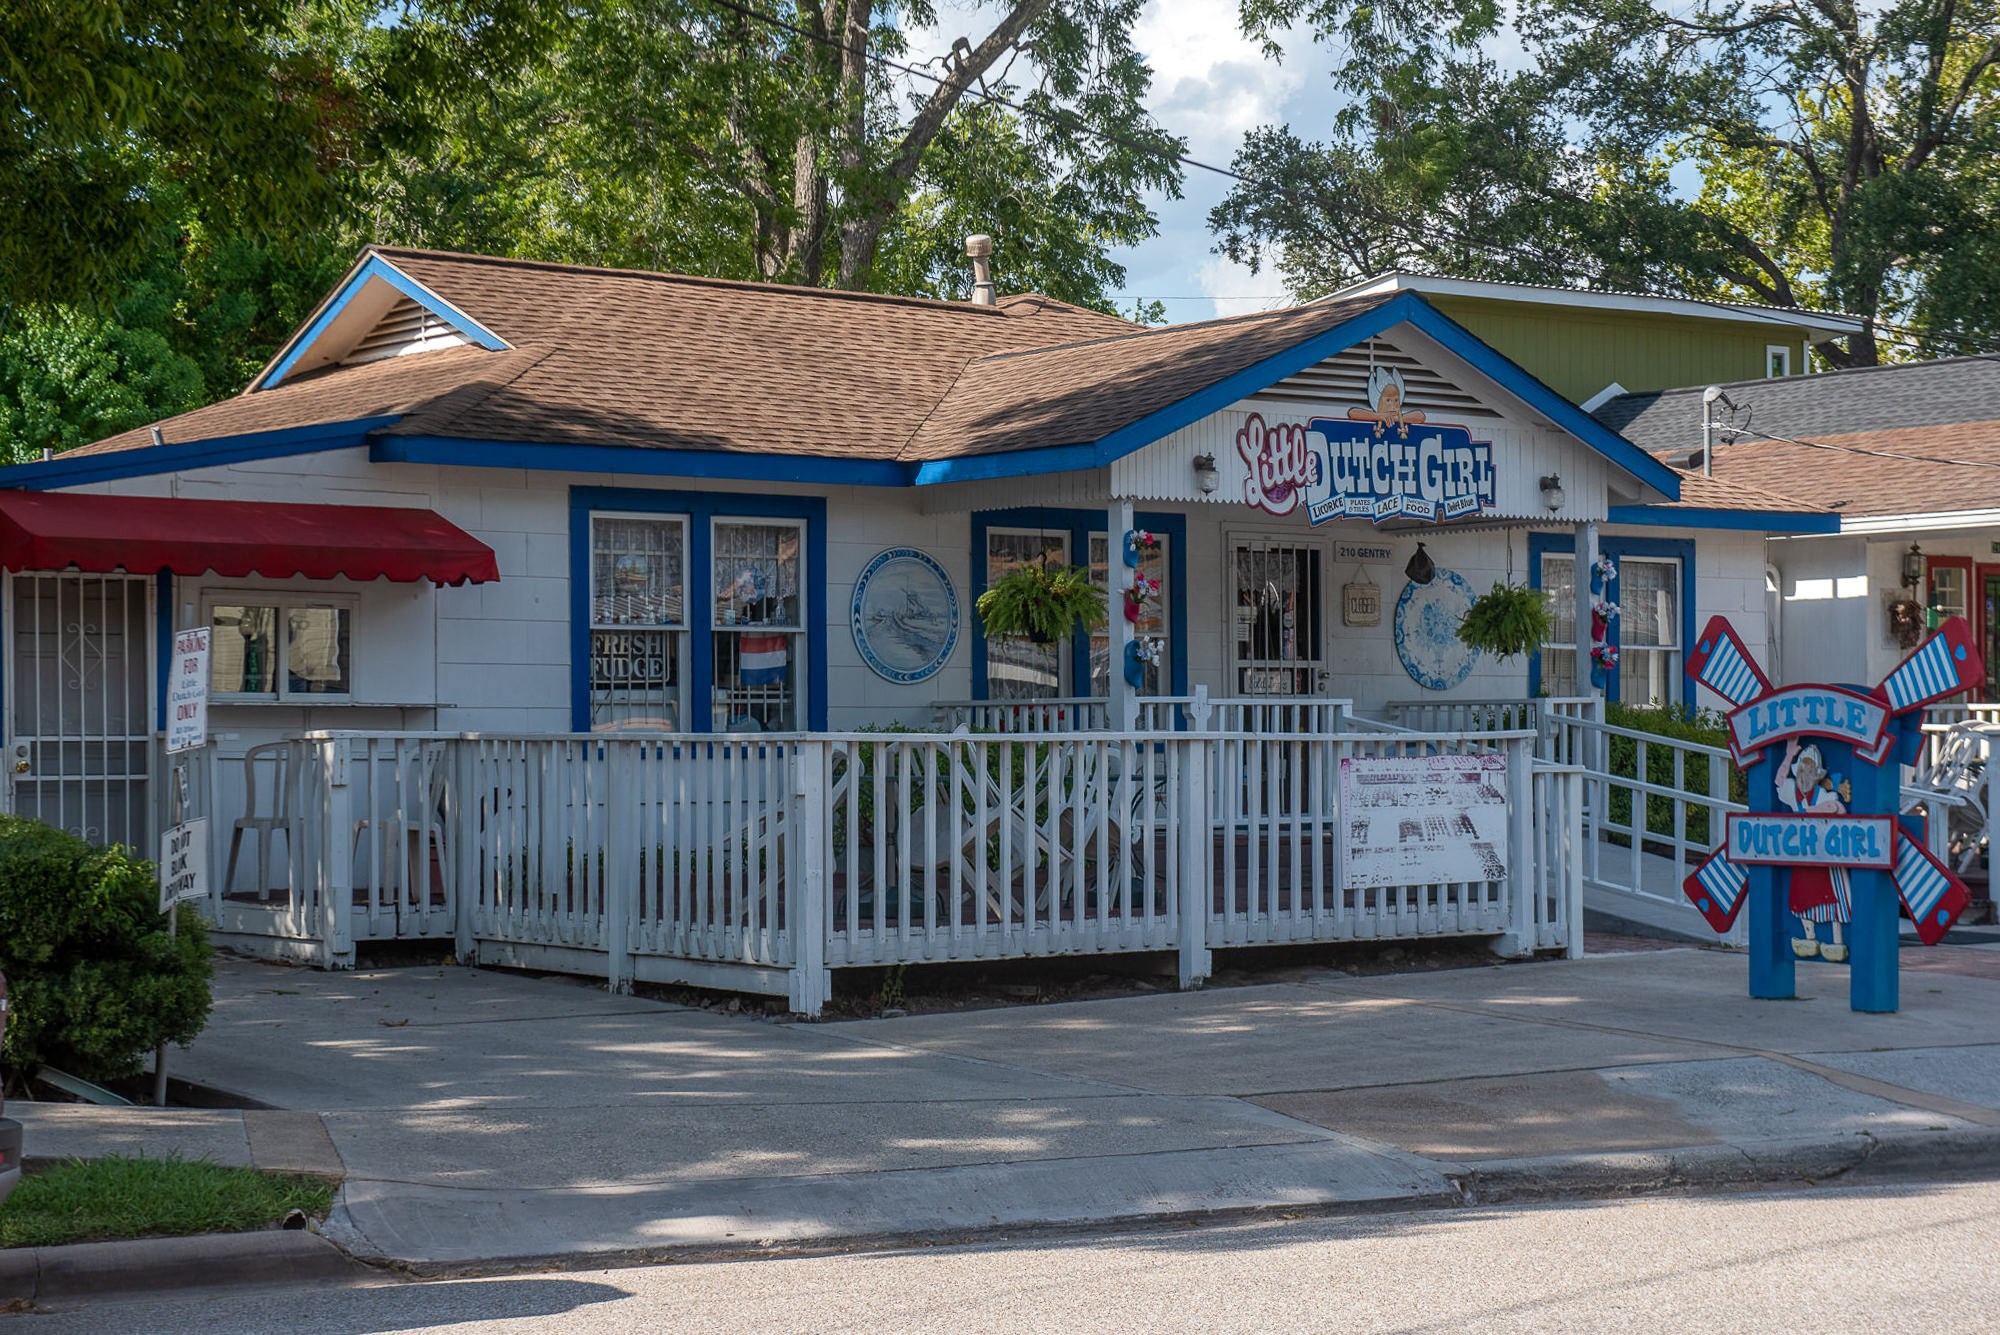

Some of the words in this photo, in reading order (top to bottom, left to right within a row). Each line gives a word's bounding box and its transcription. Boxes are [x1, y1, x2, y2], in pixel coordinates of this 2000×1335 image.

[1237, 413, 1319, 516] Little
[1305, 431, 1416, 505] DUTCH
[1419, 434, 1492, 503] GIRL
[1312, 497, 1344, 518] LICORICE
[1377, 497, 1398, 515] LACE
[1401, 503, 1430, 514] FOOD
[1340, 547, 1356, 558] 210
[1357, 548, 1391, 559] GENTRY
[591, 634, 662, 655] FRESH
[184, 657, 198, 674] FOR
[590, 657, 664, 678] FUDGE
[177, 702, 198, 720] ONLY
[1748, 695, 1868, 741] LITTLE
[1738, 820, 1818, 857] DUTCH
[1824, 824, 1880, 858] GIRL
